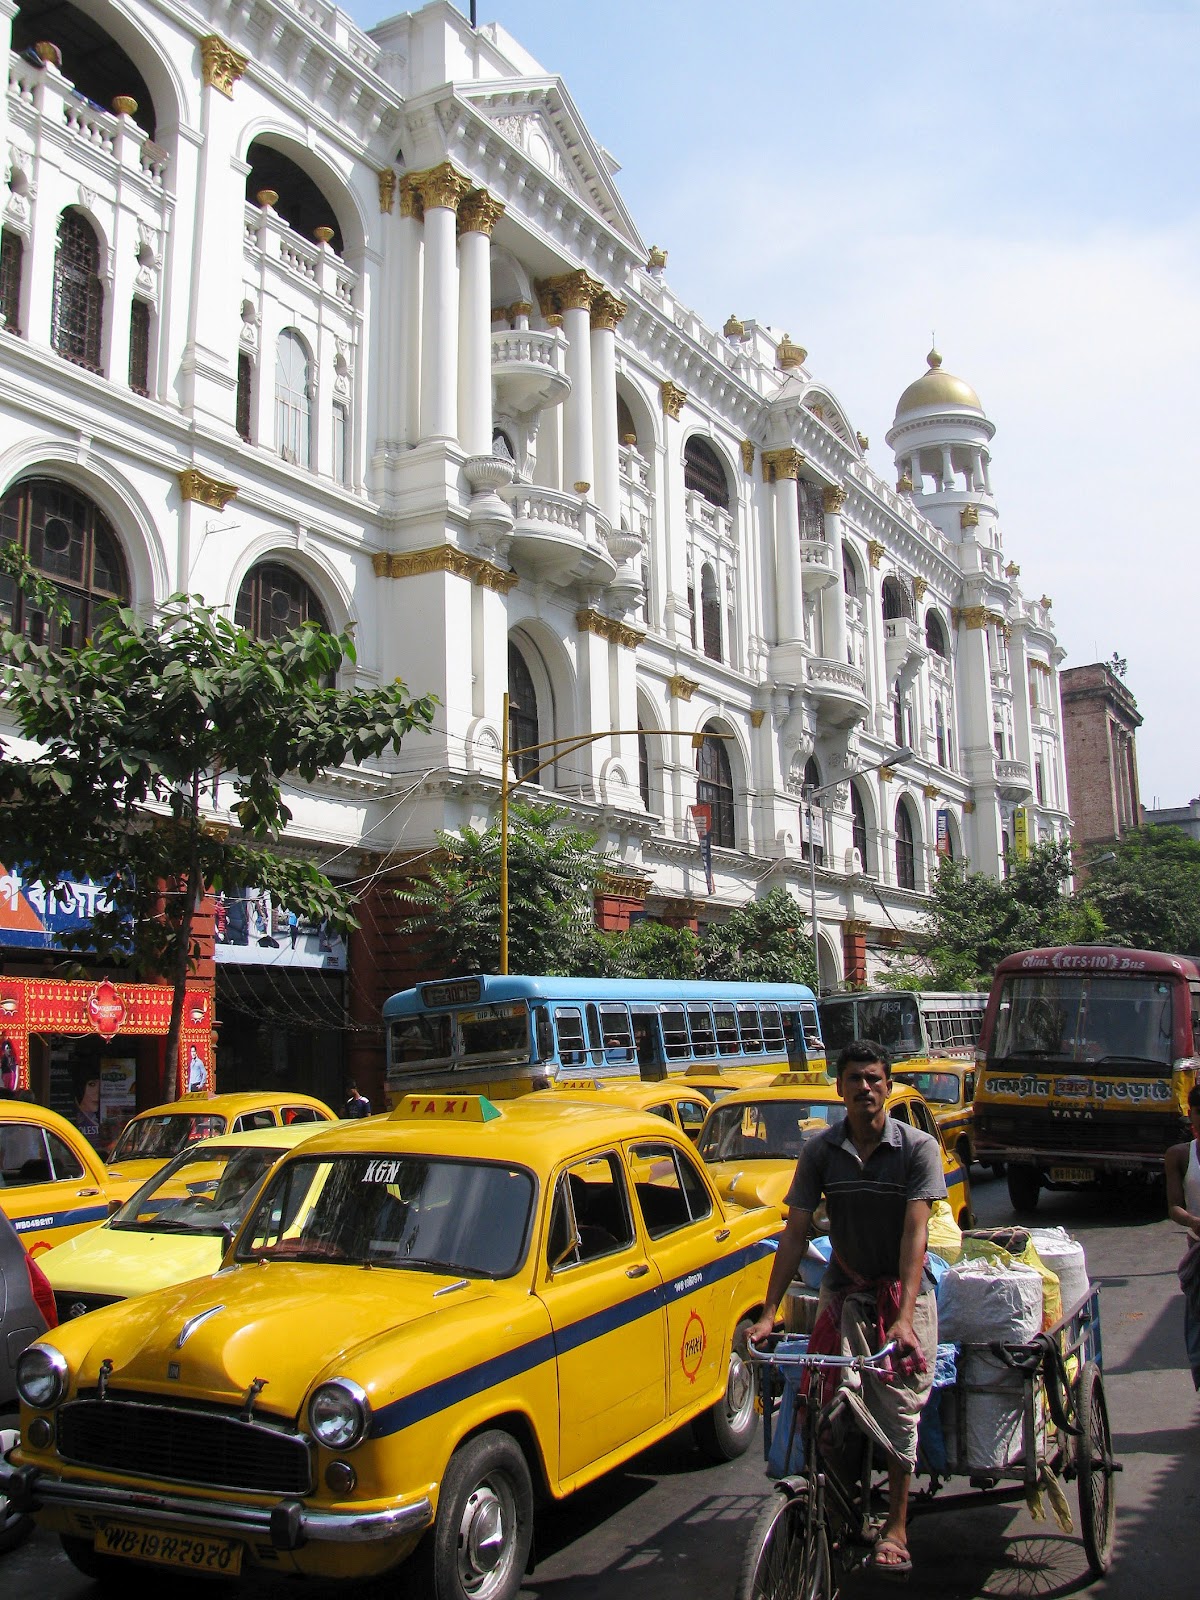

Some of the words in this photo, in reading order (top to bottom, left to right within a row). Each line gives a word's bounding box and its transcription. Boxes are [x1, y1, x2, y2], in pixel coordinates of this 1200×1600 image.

[938, 816, 947, 838] BAZAAR
[938, 839, 946, 850] BIG
[1022, 955, 1049, 968] Mini
[1120, 958, 1145, 969] Bus
[900, 1013, 916, 1026] 12
[780, 1072, 821, 1084] TAXI
[562, 1081, 592, 1089] TAXI
[410, 1100, 469, 1114] TAXI
[1051, 1109, 1094, 1119] TATA
[361, 1159, 403, 1184] KGN
[685, 1335, 702, 1358] TAXI
